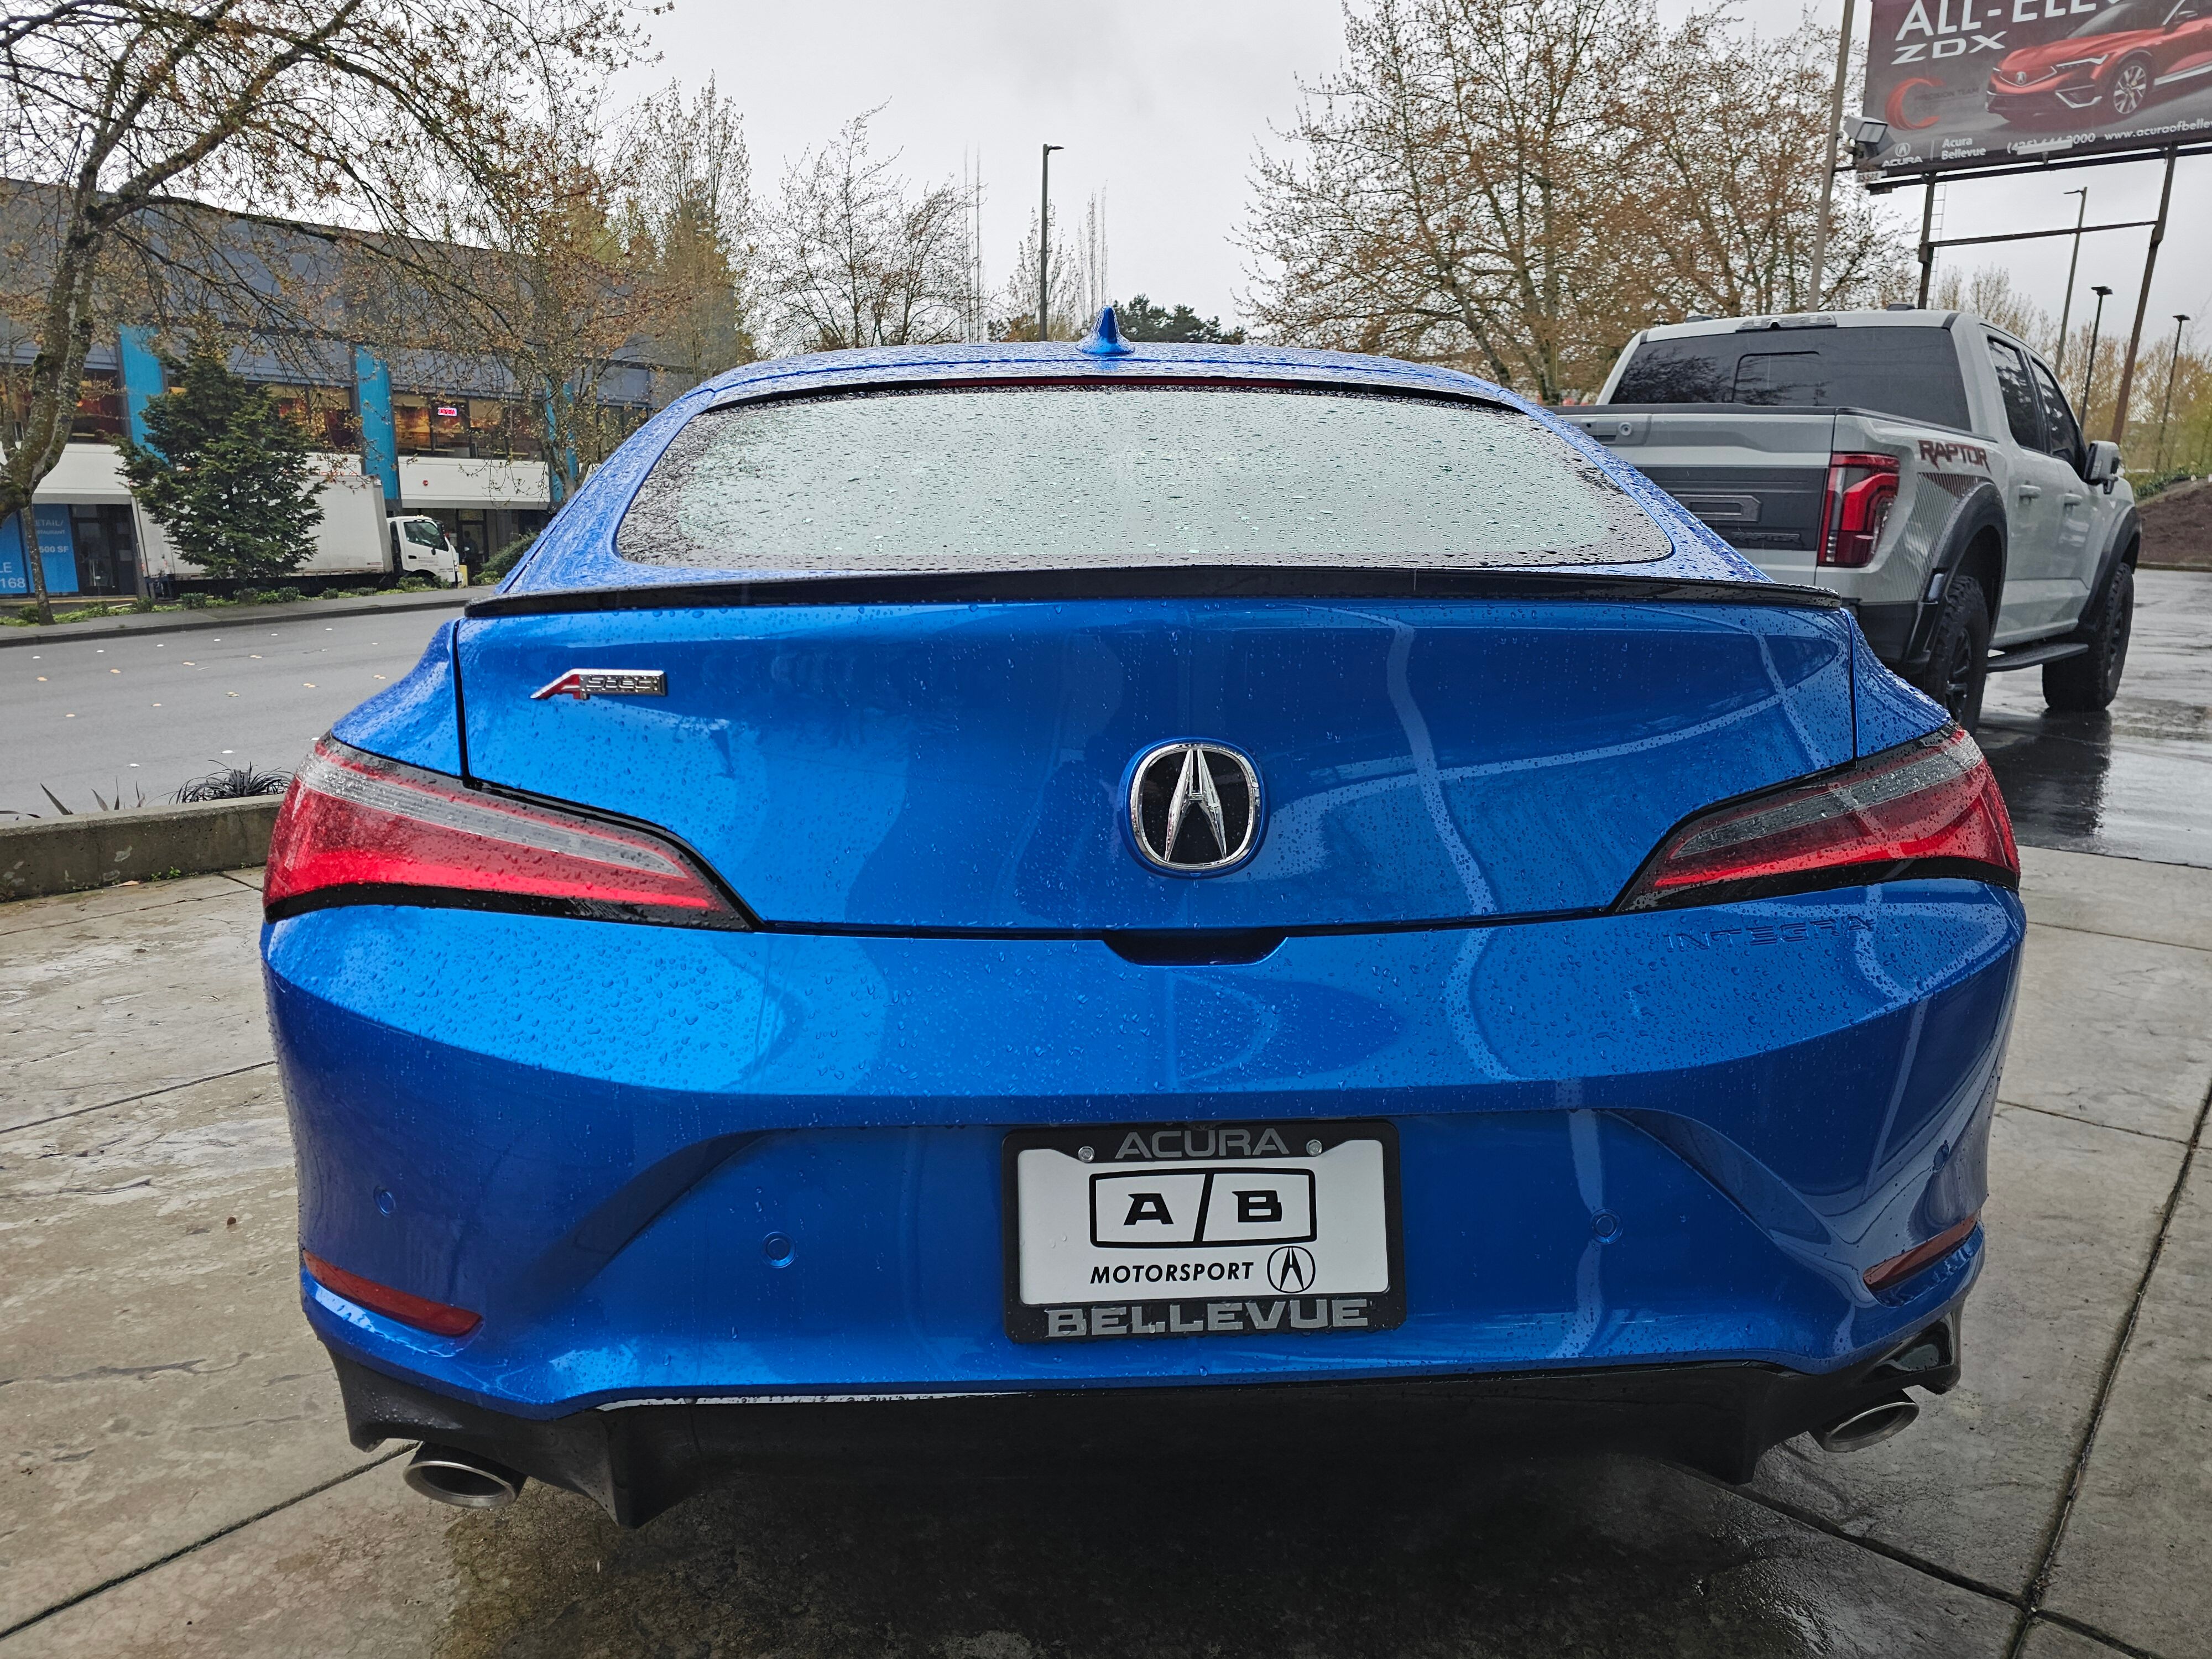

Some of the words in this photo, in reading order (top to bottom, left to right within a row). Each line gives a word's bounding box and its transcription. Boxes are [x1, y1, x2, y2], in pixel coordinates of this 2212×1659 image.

[1891, 31, 2007, 65] ZDX
[1941, 147, 1986, 160] Bellevue
[1942, 138, 1973, 148] Acura
[1881, 156, 1923, 168] ACURA
[1917, 440, 1992, 476] RAPTOR
[1663, 915, 1876, 953] INTEGRA
[1115, 1128, 1290, 1160] ACURA
[1090, 1261, 1254, 1284] MOTORSPORT
[1045, 1298, 1369, 1338] BELLEVUE
